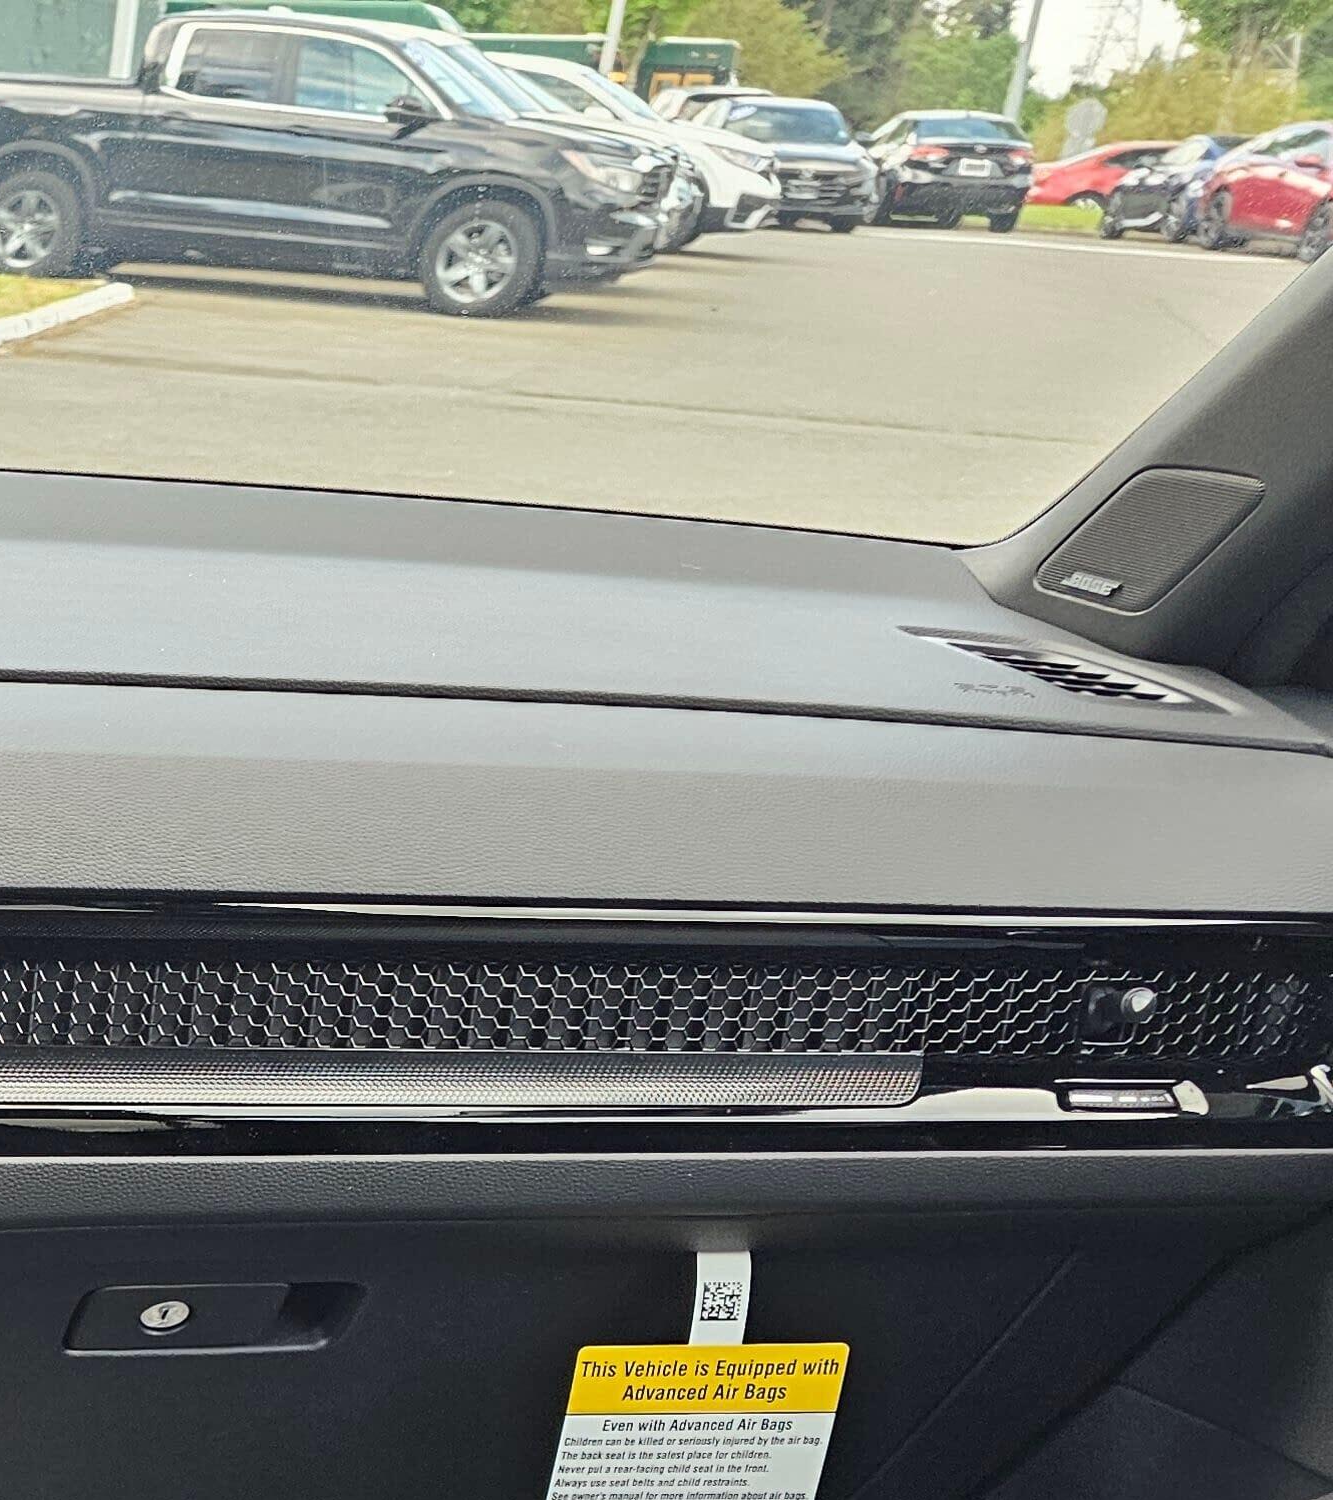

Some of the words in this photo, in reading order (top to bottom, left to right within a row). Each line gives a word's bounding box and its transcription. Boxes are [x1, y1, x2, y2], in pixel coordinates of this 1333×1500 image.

[581, 1361, 616, 1378] This
[625, 1360, 688, 1377] Vehicle
[695, 1360, 709, 1377] is
[715, 1360, 796, 1380] Equipped
[803, 1359, 839, 1376] with
[622, 1384, 707, 1401] Advanced
[713, 1384, 739, 1400] Air
[745, 1384, 787, 1403] Bags
[602, 1420, 633, 1432] Even
[638, 1420, 665, 1431] with
[669, 1419, 733, 1431] Advanced
[737, 1419, 756, 1431] Air
[761, 1419, 793, 1432] Bags
[564, 1437, 602, 1446] Children
[605, 1438, 621, 1446] can
[624, 1437, 635, 1446] be
[638, 1436, 664, 1445] killed
[679, 1437, 720, 1446] seriously
[723, 1436, 755, 1446] injured
[755, 1437, 767, 1446] by
[771, 1436, 785, 1445] the
[788, 1436, 801, 1444] air
[803, 1436, 823, 1446] bag.
[562, 1451, 578, 1460] The
[581, 1451, 602, 1460] back
[606, 1452, 625, 1460] seat
[627, 1452, 636, 1460] is
[639, 1451, 653, 1460] the
[656, 1451, 684, 1460] safest
[687, 1451, 712, 1461] place
[716, 1451, 728, 1459] for
[731, 1451, 772, 1459] children.
[558, 1465, 585, 1474] Never
[587, 1466, 602, 1475] put
[614, 1465, 665, 1474] rear-facing
[668, 1465, 690, 1473] child
[693, 1465, 713, 1473] seat
[727, 1464, 742, 1473] the
[745, 1464, 769, 1472] front.
[555, 1478, 588, 1488] Always
[591, 1480, 606, 1488] use
[609, 1478, 629, 1487] seat
[632, 1478, 655, 1487] belts
[658, 1478, 675, 1487] and
[678, 1478, 700, 1487] child
[703, 1478, 749, 1486] restraints.
[552, 1492, 569, 1500] See
[571, 1492, 606, 1500] owner's
[609, 1492, 643, 1500] manual
[646, 1492, 657, 1500] for
[687, 1492, 739, 1500] information
[741, 1492, 767, 1500] about
[769, 1492, 781, 1500] air
